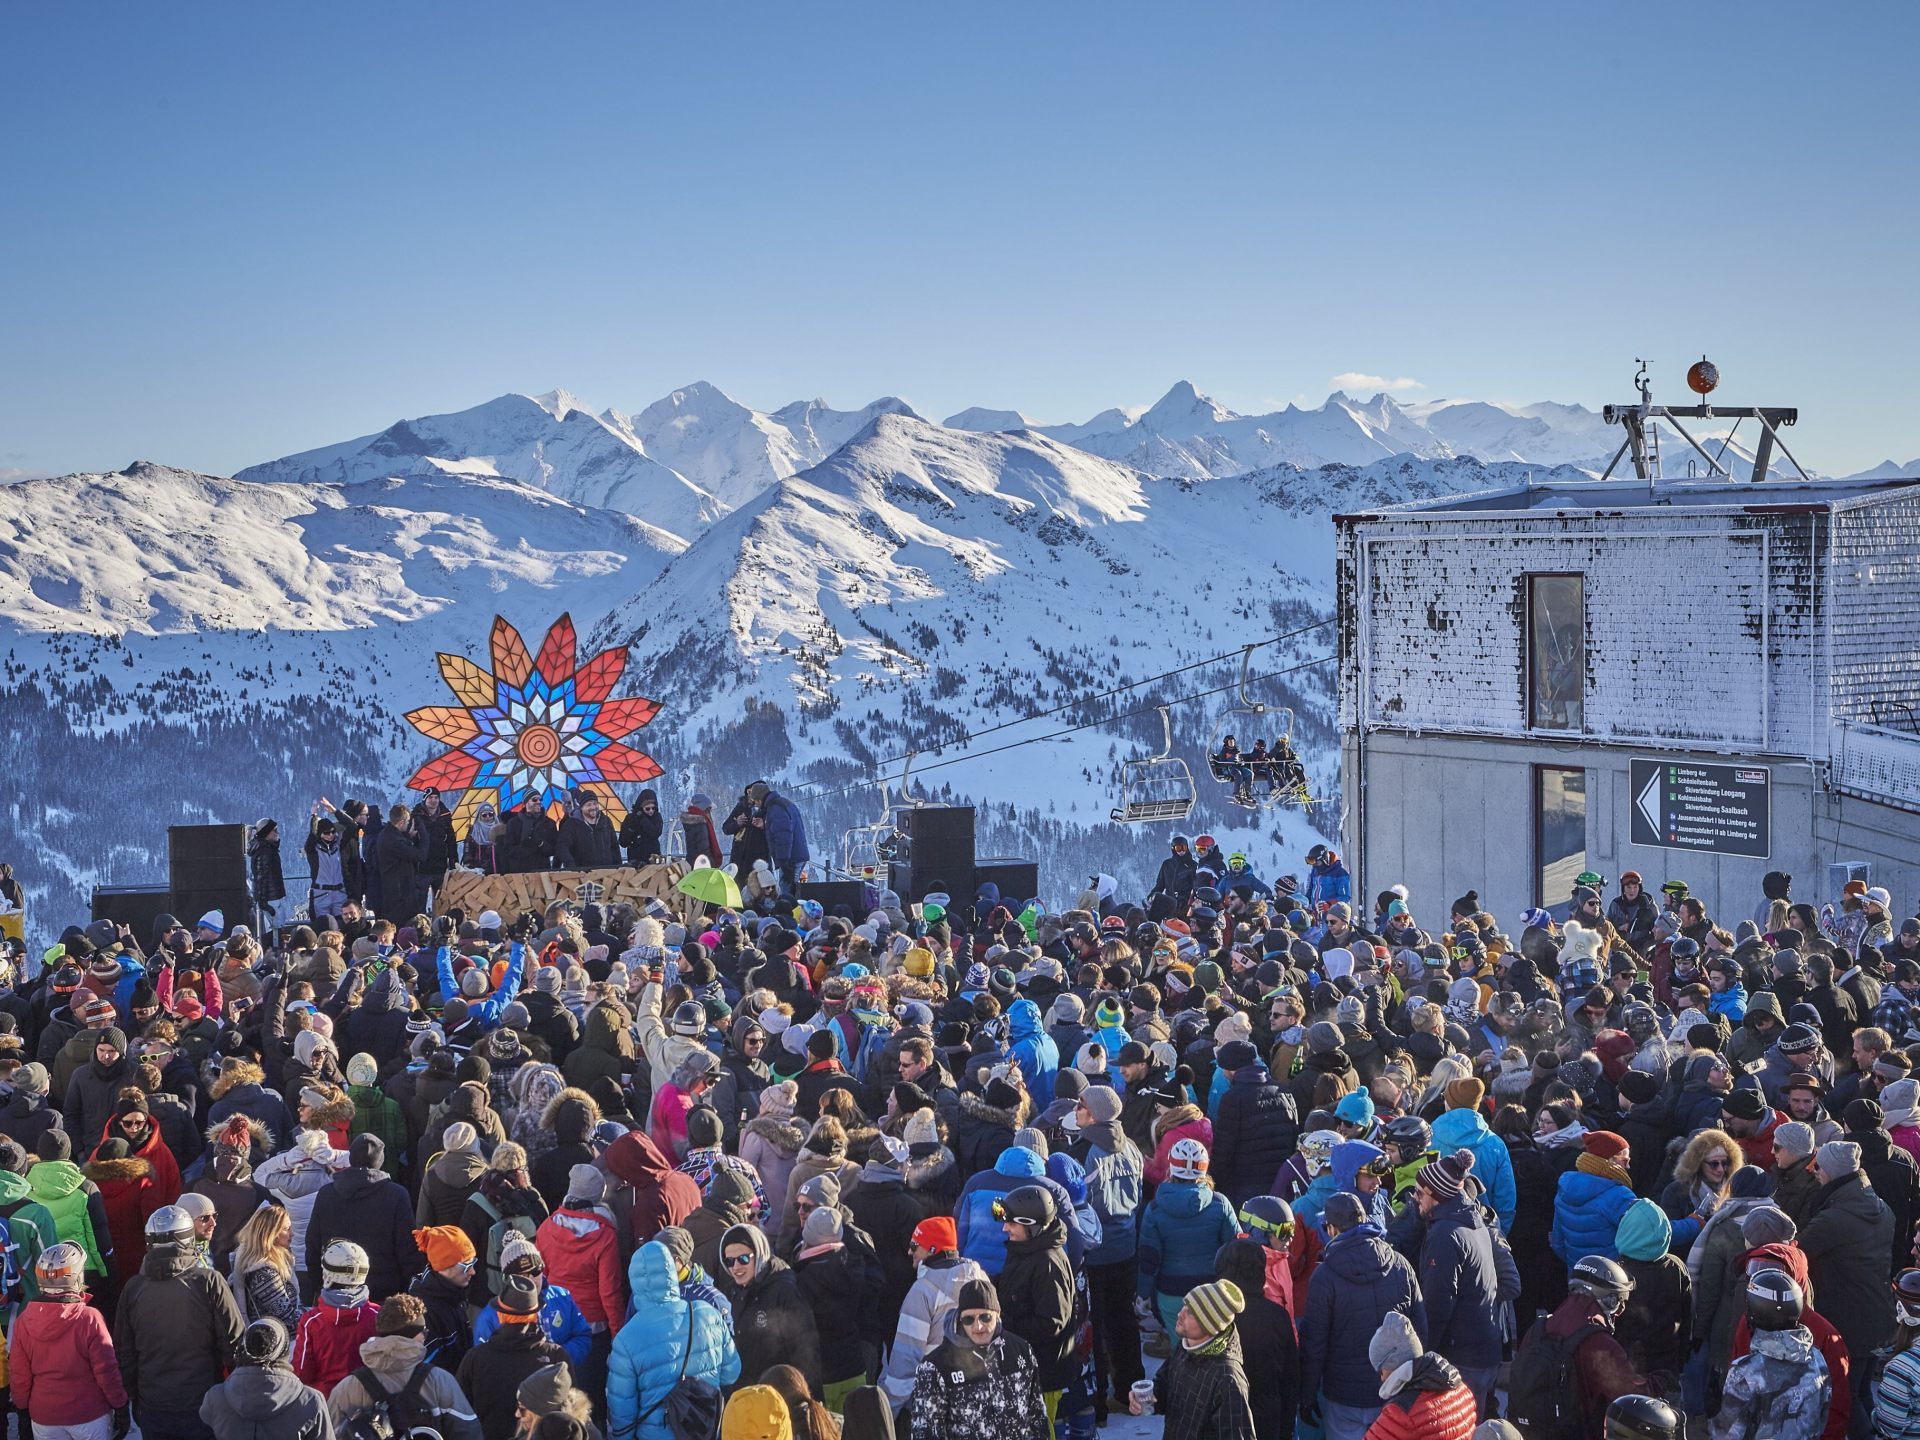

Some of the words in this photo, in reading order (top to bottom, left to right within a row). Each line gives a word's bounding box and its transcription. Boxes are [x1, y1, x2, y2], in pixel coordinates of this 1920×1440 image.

[1677, 768, 1697, 777] Limberg
[1685, 786, 1720, 797] Skiverbindung
[1721, 788, 1746, 799] Leogang
[1685, 803, 1720, 814] Skiverbindung
[1721, 805, 1748, 816] Saalbach
[1726, 818, 1747, 828] Limberg
[1727, 830, 1748, 840] Limberg
[1677, 836, 1714, 846] Limbergabfahrt
[951, 1370, 965, 1384] 09
